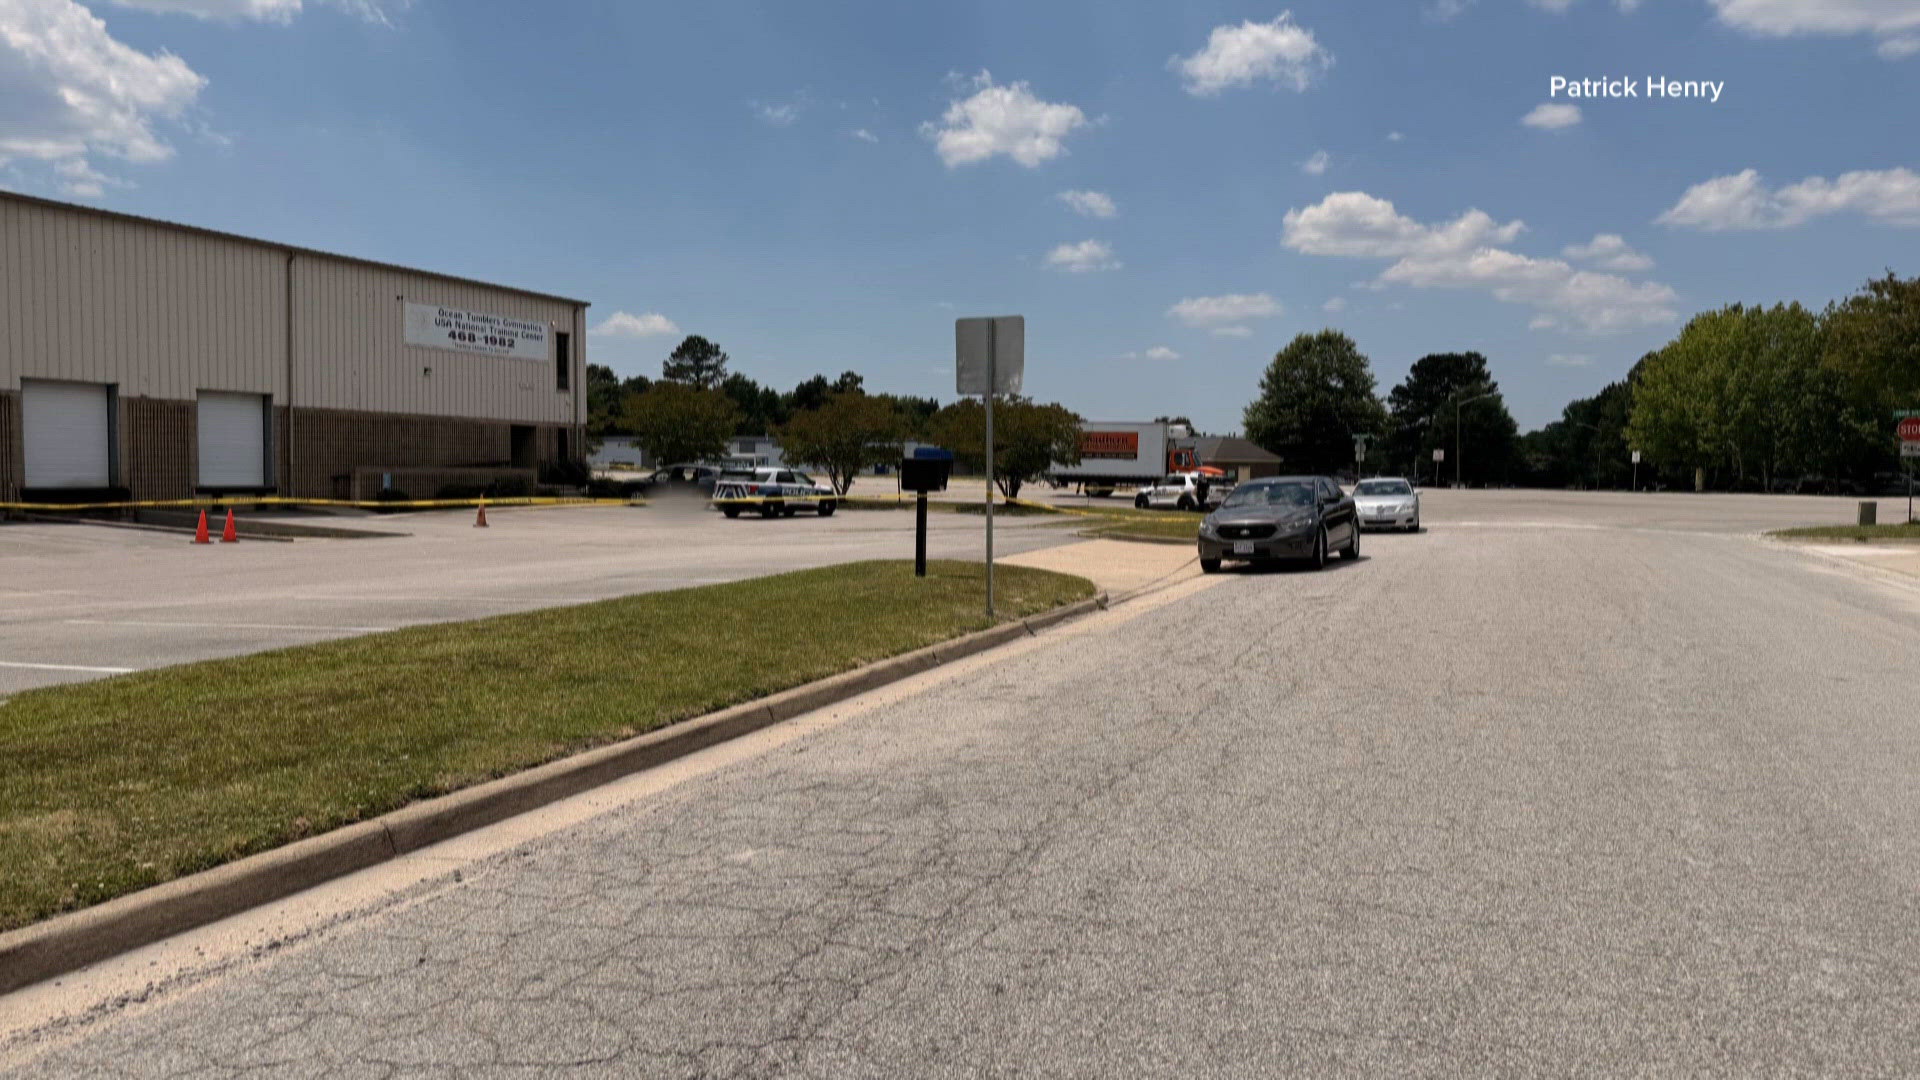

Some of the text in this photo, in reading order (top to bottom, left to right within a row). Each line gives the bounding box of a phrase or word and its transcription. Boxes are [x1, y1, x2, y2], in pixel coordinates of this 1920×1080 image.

[434, 317, 543, 343] USA National Training Center
[438, 307, 542, 332] Ocean Tumblers Gymnastics
[448, 330, 515, 349] 468-1982
